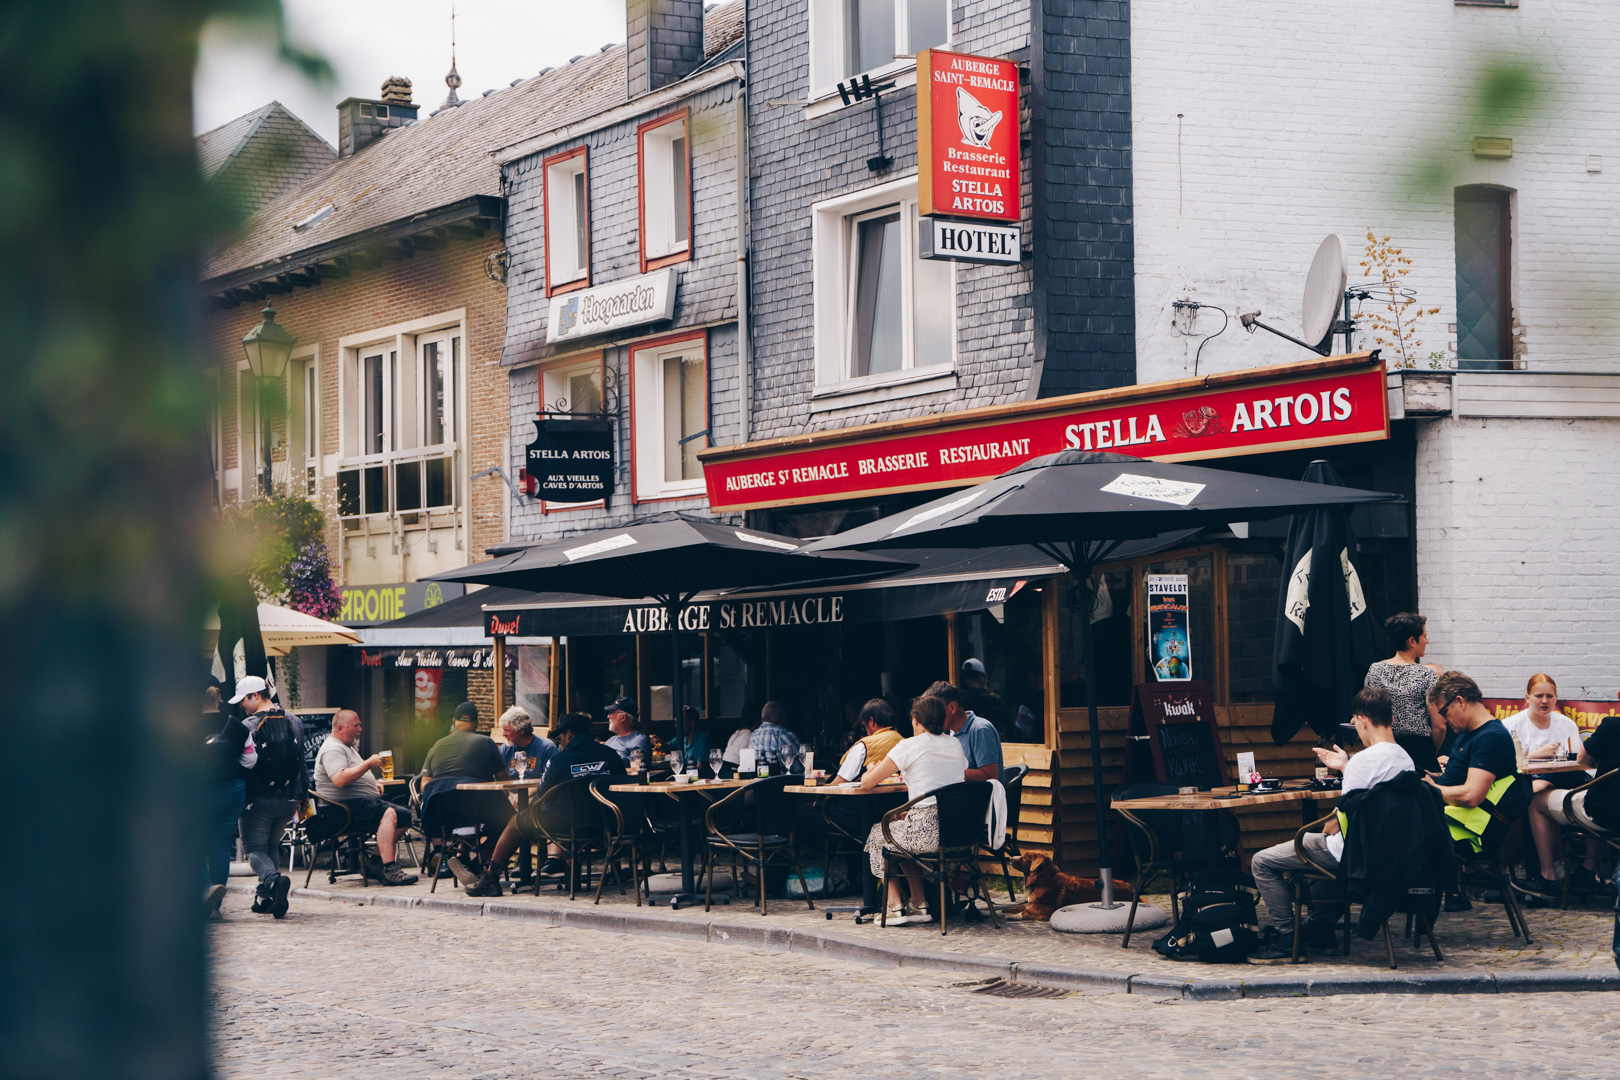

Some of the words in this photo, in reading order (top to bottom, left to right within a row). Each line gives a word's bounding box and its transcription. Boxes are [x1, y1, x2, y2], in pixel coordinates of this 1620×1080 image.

[951, 58, 1000, 76] AUBERGE
[934, 70, 1015, 92] SAINT-REMACLE
[948, 147, 1006, 165] Brasserie
[943, 160, 1011, 179] Restaurant
[952, 179, 1003, 197] STELLA
[952, 196, 1005, 214] ARTOIS
[940, 227, 1012, 255] HOTEL
[581, 284, 655, 325] Hoegaarden
[1065, 414, 1167, 451] STELLA
[1230, 387, 1353, 434] ARTOIS
[529, 449, 569, 459] STELLA
[572, 450, 611, 460] ARTOIS
[726, 471, 777, 491] AUBERGE
[792, 462, 849, 484] REMACLE
[858, 452, 929, 476] BRASSERIE
[939, 438, 1031, 465] RESTAURANT
[1149, 584, 1187, 592] STAVELOT
[719, 603, 737, 629] St
[741, 596, 844, 628] REMACLE
[490, 614, 521, 635] Duvel
[361, 649, 382, 667] Duvel
[395, 650, 413, 667] Aux
